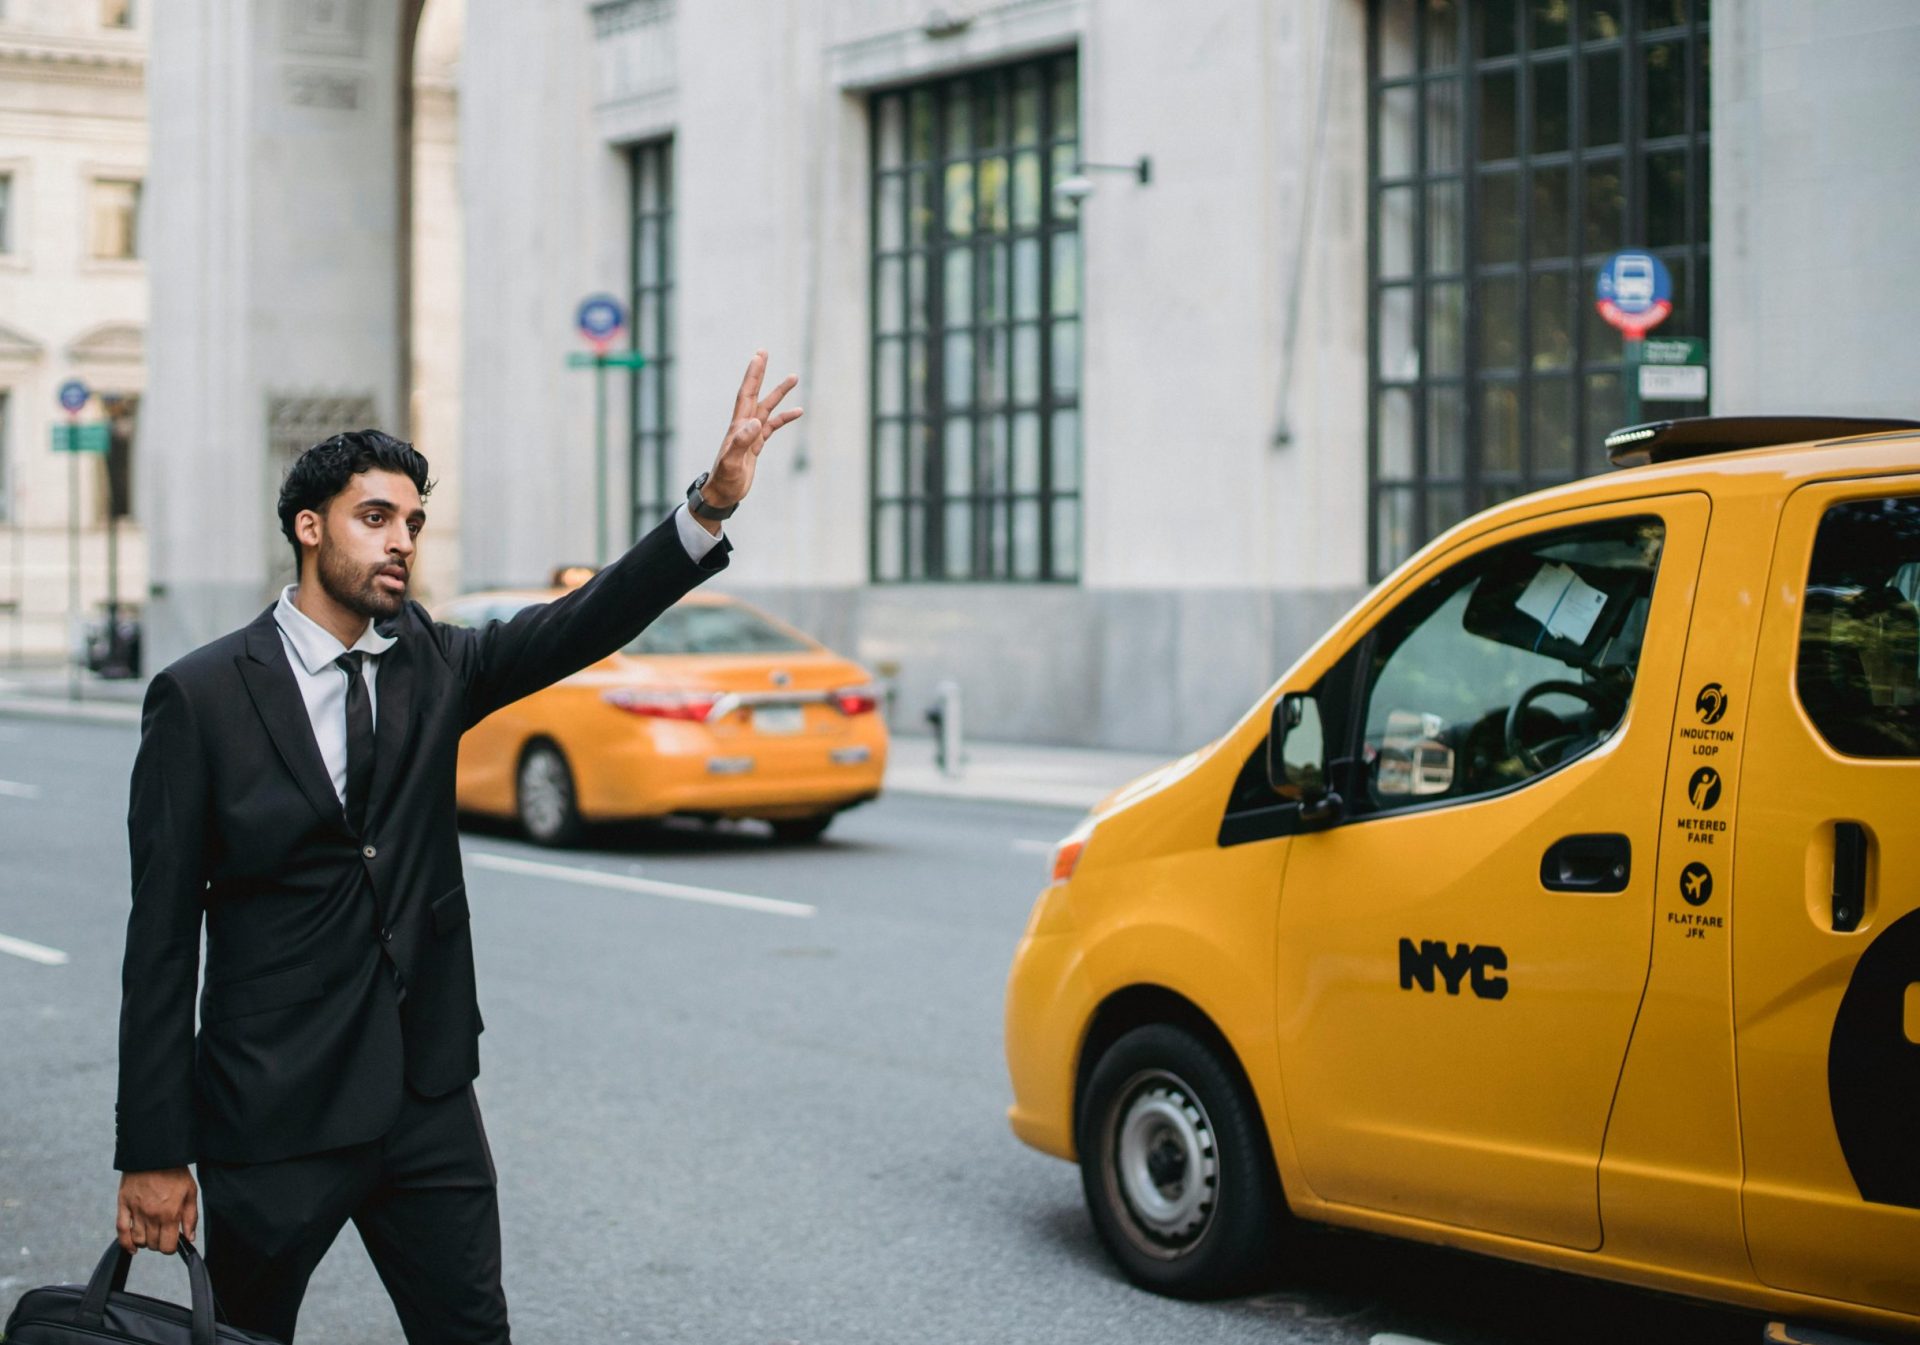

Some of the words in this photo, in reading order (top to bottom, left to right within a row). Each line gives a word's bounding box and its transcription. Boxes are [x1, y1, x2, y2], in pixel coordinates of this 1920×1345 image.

[1680, 728, 1734, 742] INDUCTION
[1692, 745, 1719, 756] LOOP
[1677, 818, 1727, 832] METERED
[1687, 832, 1714, 845] FARE
[1668, 912, 1693, 925] FLAT
[1696, 915, 1723, 928] FARE
[1685, 928, 1705, 939] JFK
[1399, 937, 1508, 1001] NYC
